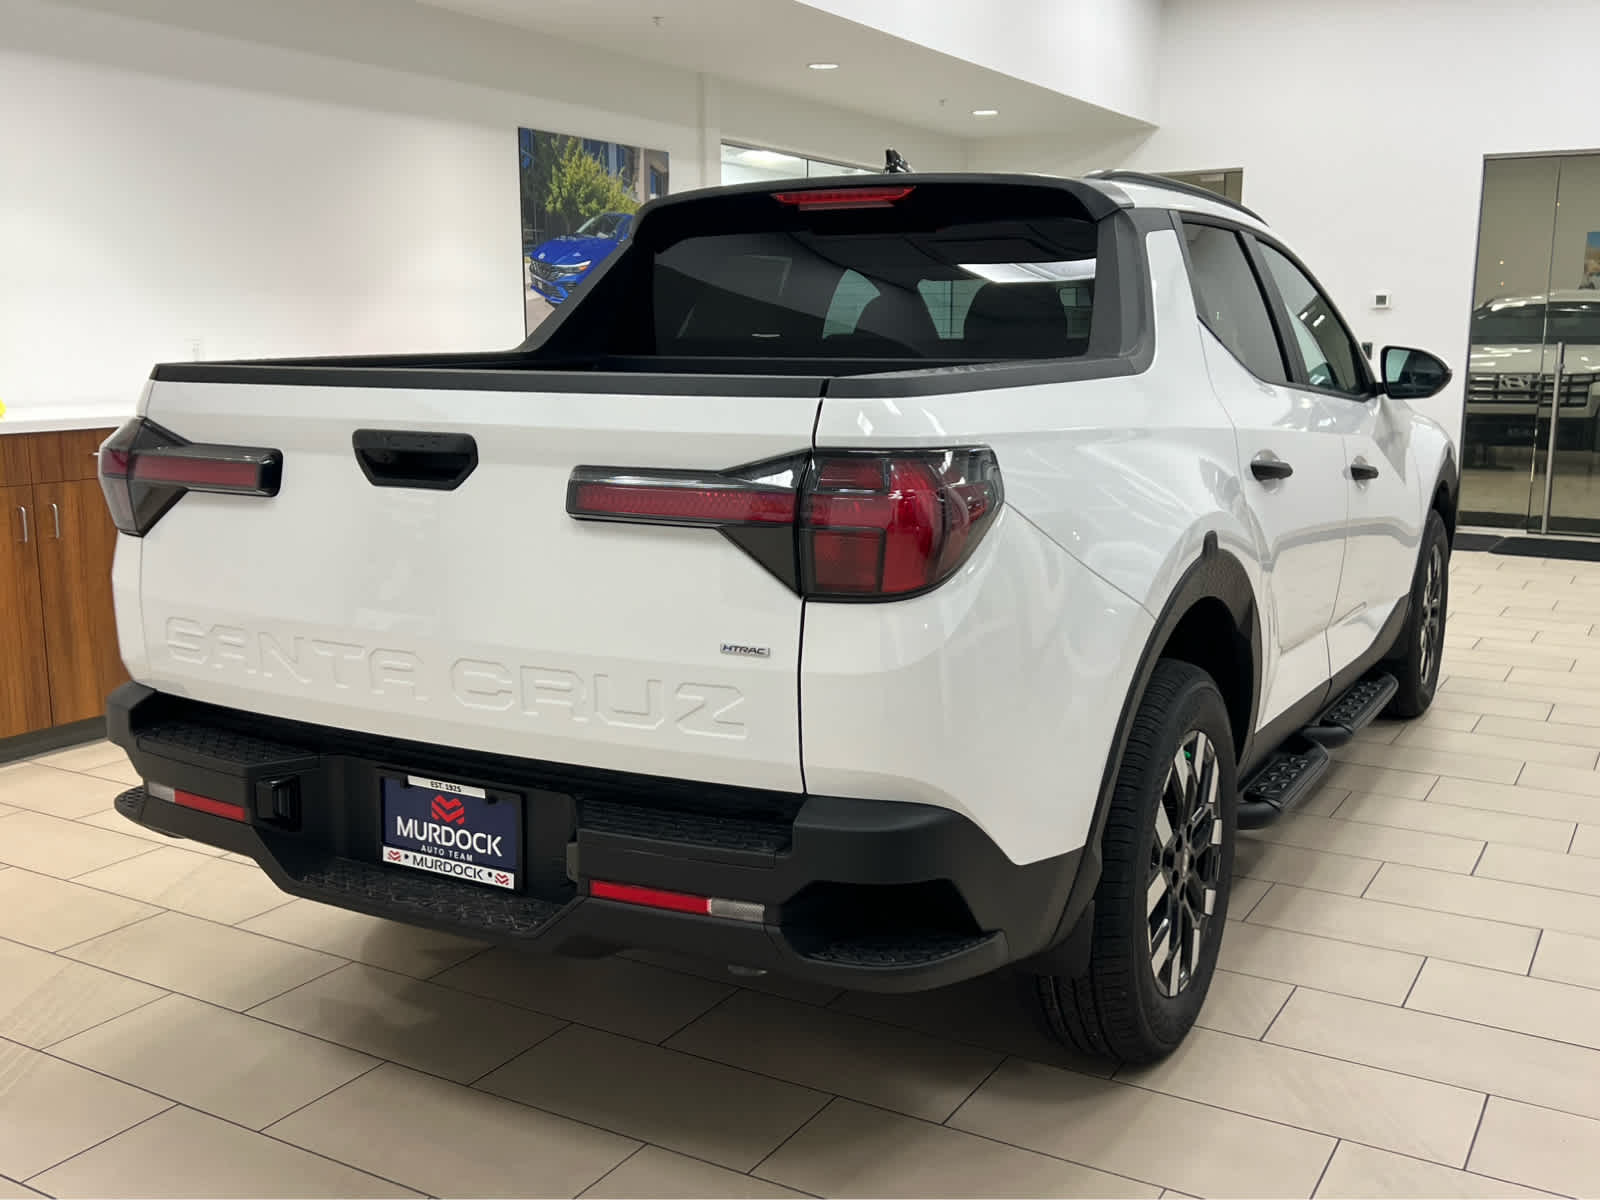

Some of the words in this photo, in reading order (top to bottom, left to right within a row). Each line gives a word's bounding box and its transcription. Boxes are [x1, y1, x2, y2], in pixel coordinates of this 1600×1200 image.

[721, 643, 768, 656] HTRAC
[165, 616, 430, 702] SANTA
[449, 656, 749, 741] CRUZ
[430, 780, 445, 789] EST.
[445, 782, 462, 793] 1925
[396, 815, 503, 857] MURDOCK
[420, 844, 445, 857] AUTO
[450, 851, 473, 863] TEAM
[412, 854, 484, 881] MURDOCK
